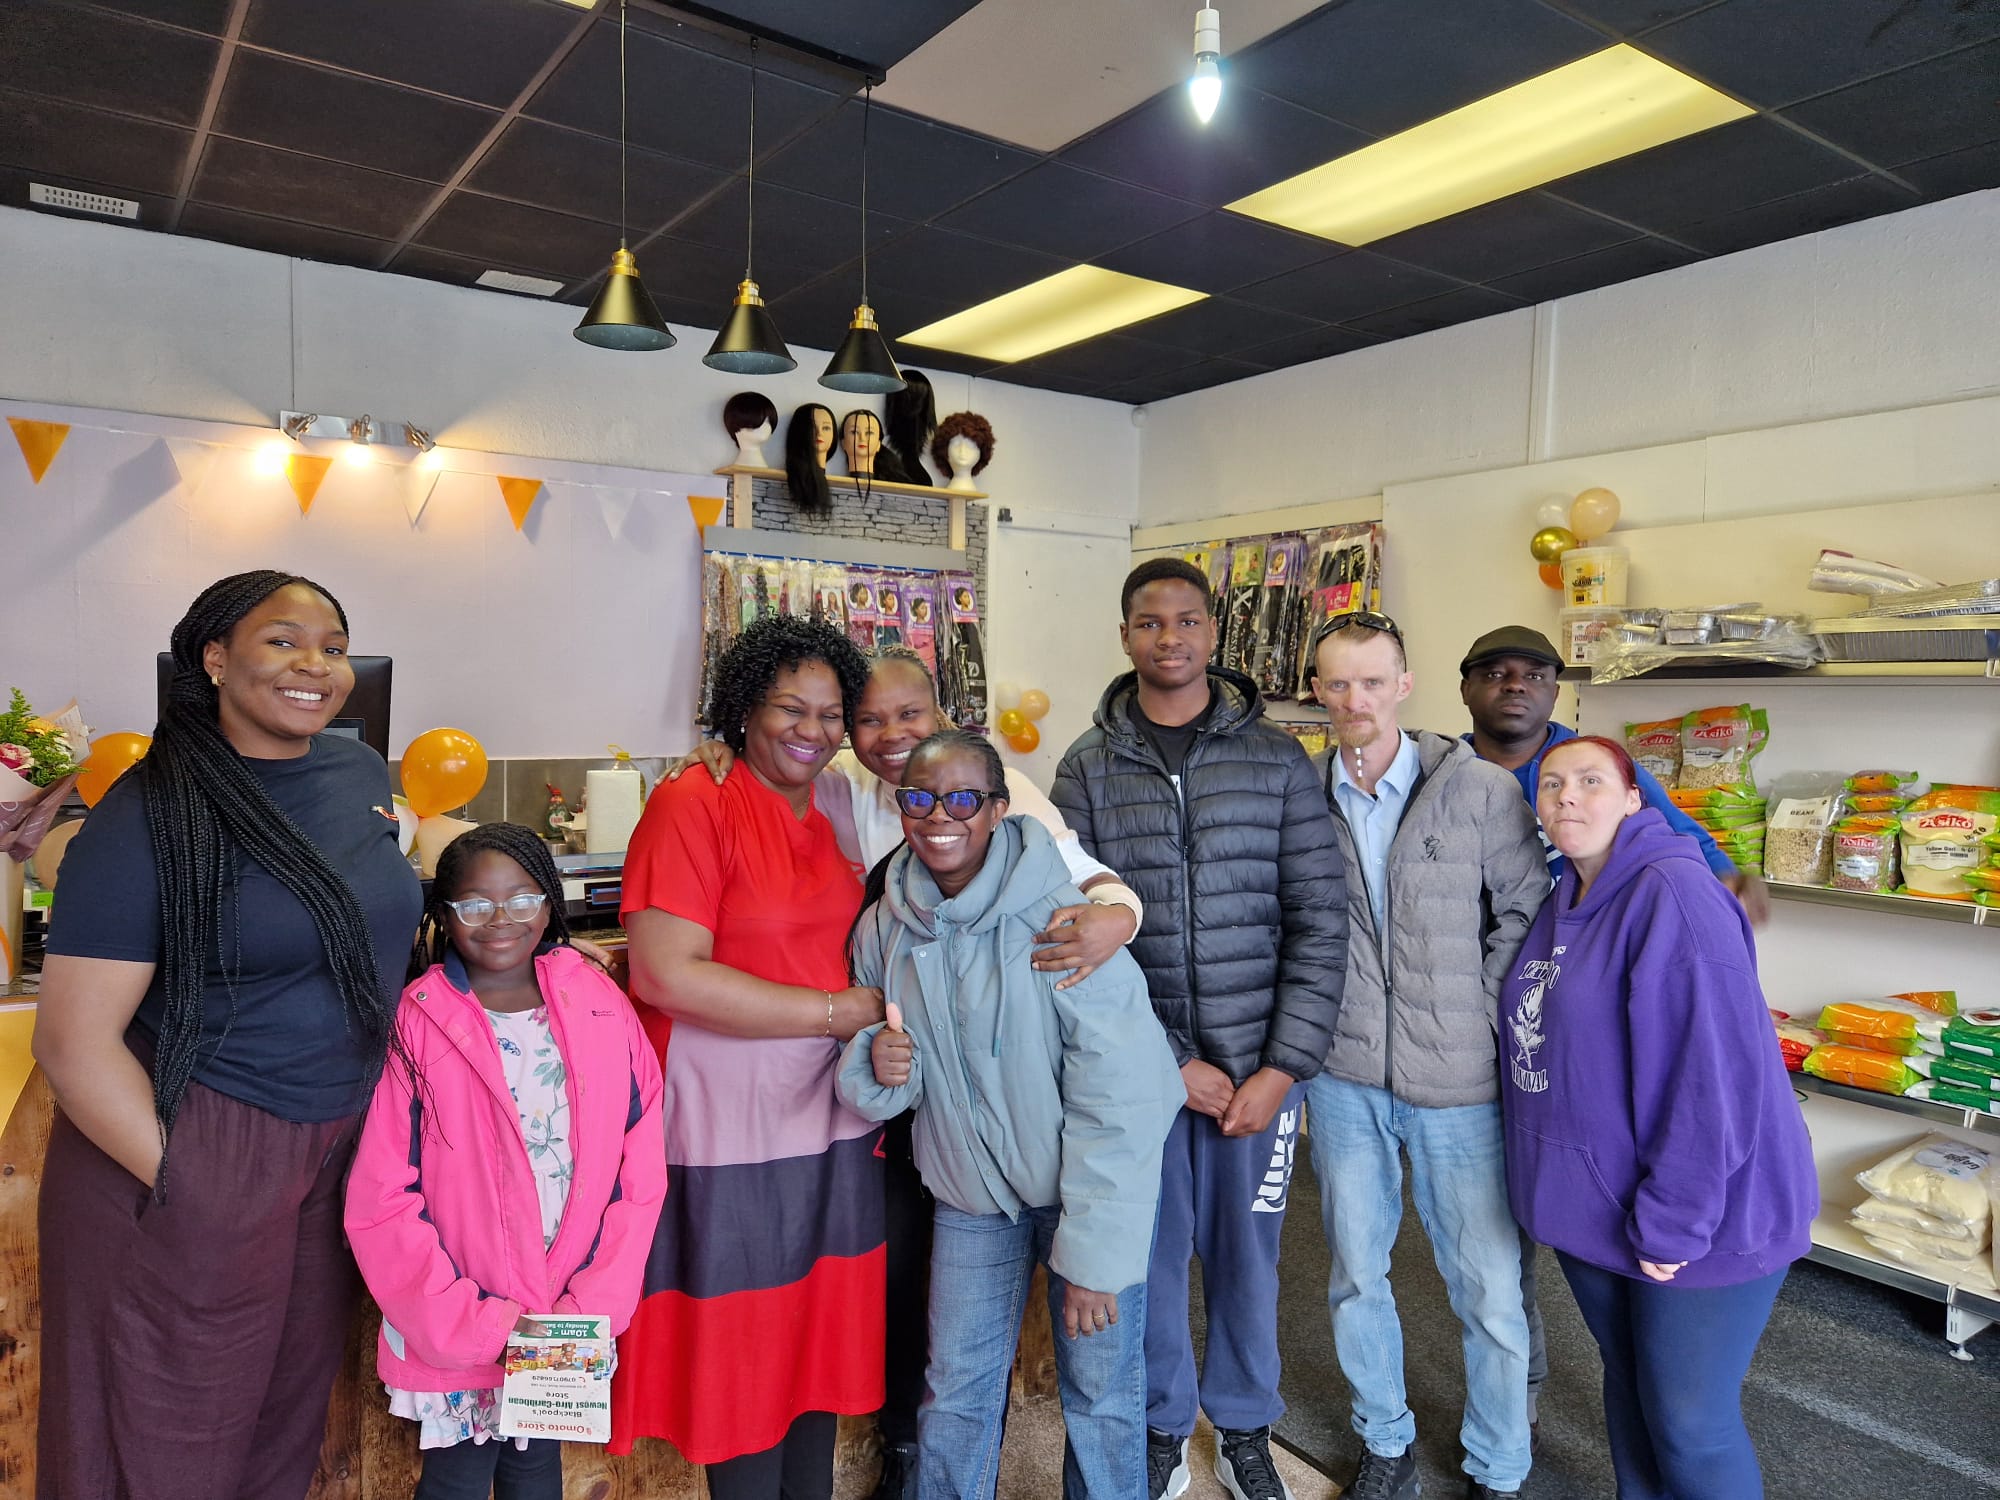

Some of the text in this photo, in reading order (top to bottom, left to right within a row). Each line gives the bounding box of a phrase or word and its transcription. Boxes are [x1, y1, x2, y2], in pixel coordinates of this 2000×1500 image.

[1695, 725, 1733, 739] Asiko
[1639, 734, 1673, 746] Asiko
[1921, 815, 1973, 829] Asiko
[1841, 837, 1877, 848] Asiko
[561, 1329, 587, 1337] 10am
[509, 1397, 607, 1410] Newest Afro-Caribbean
[532, 1409, 582, 1417] Blackpool's
[517, 1421, 585, 1433] Omoto Store
